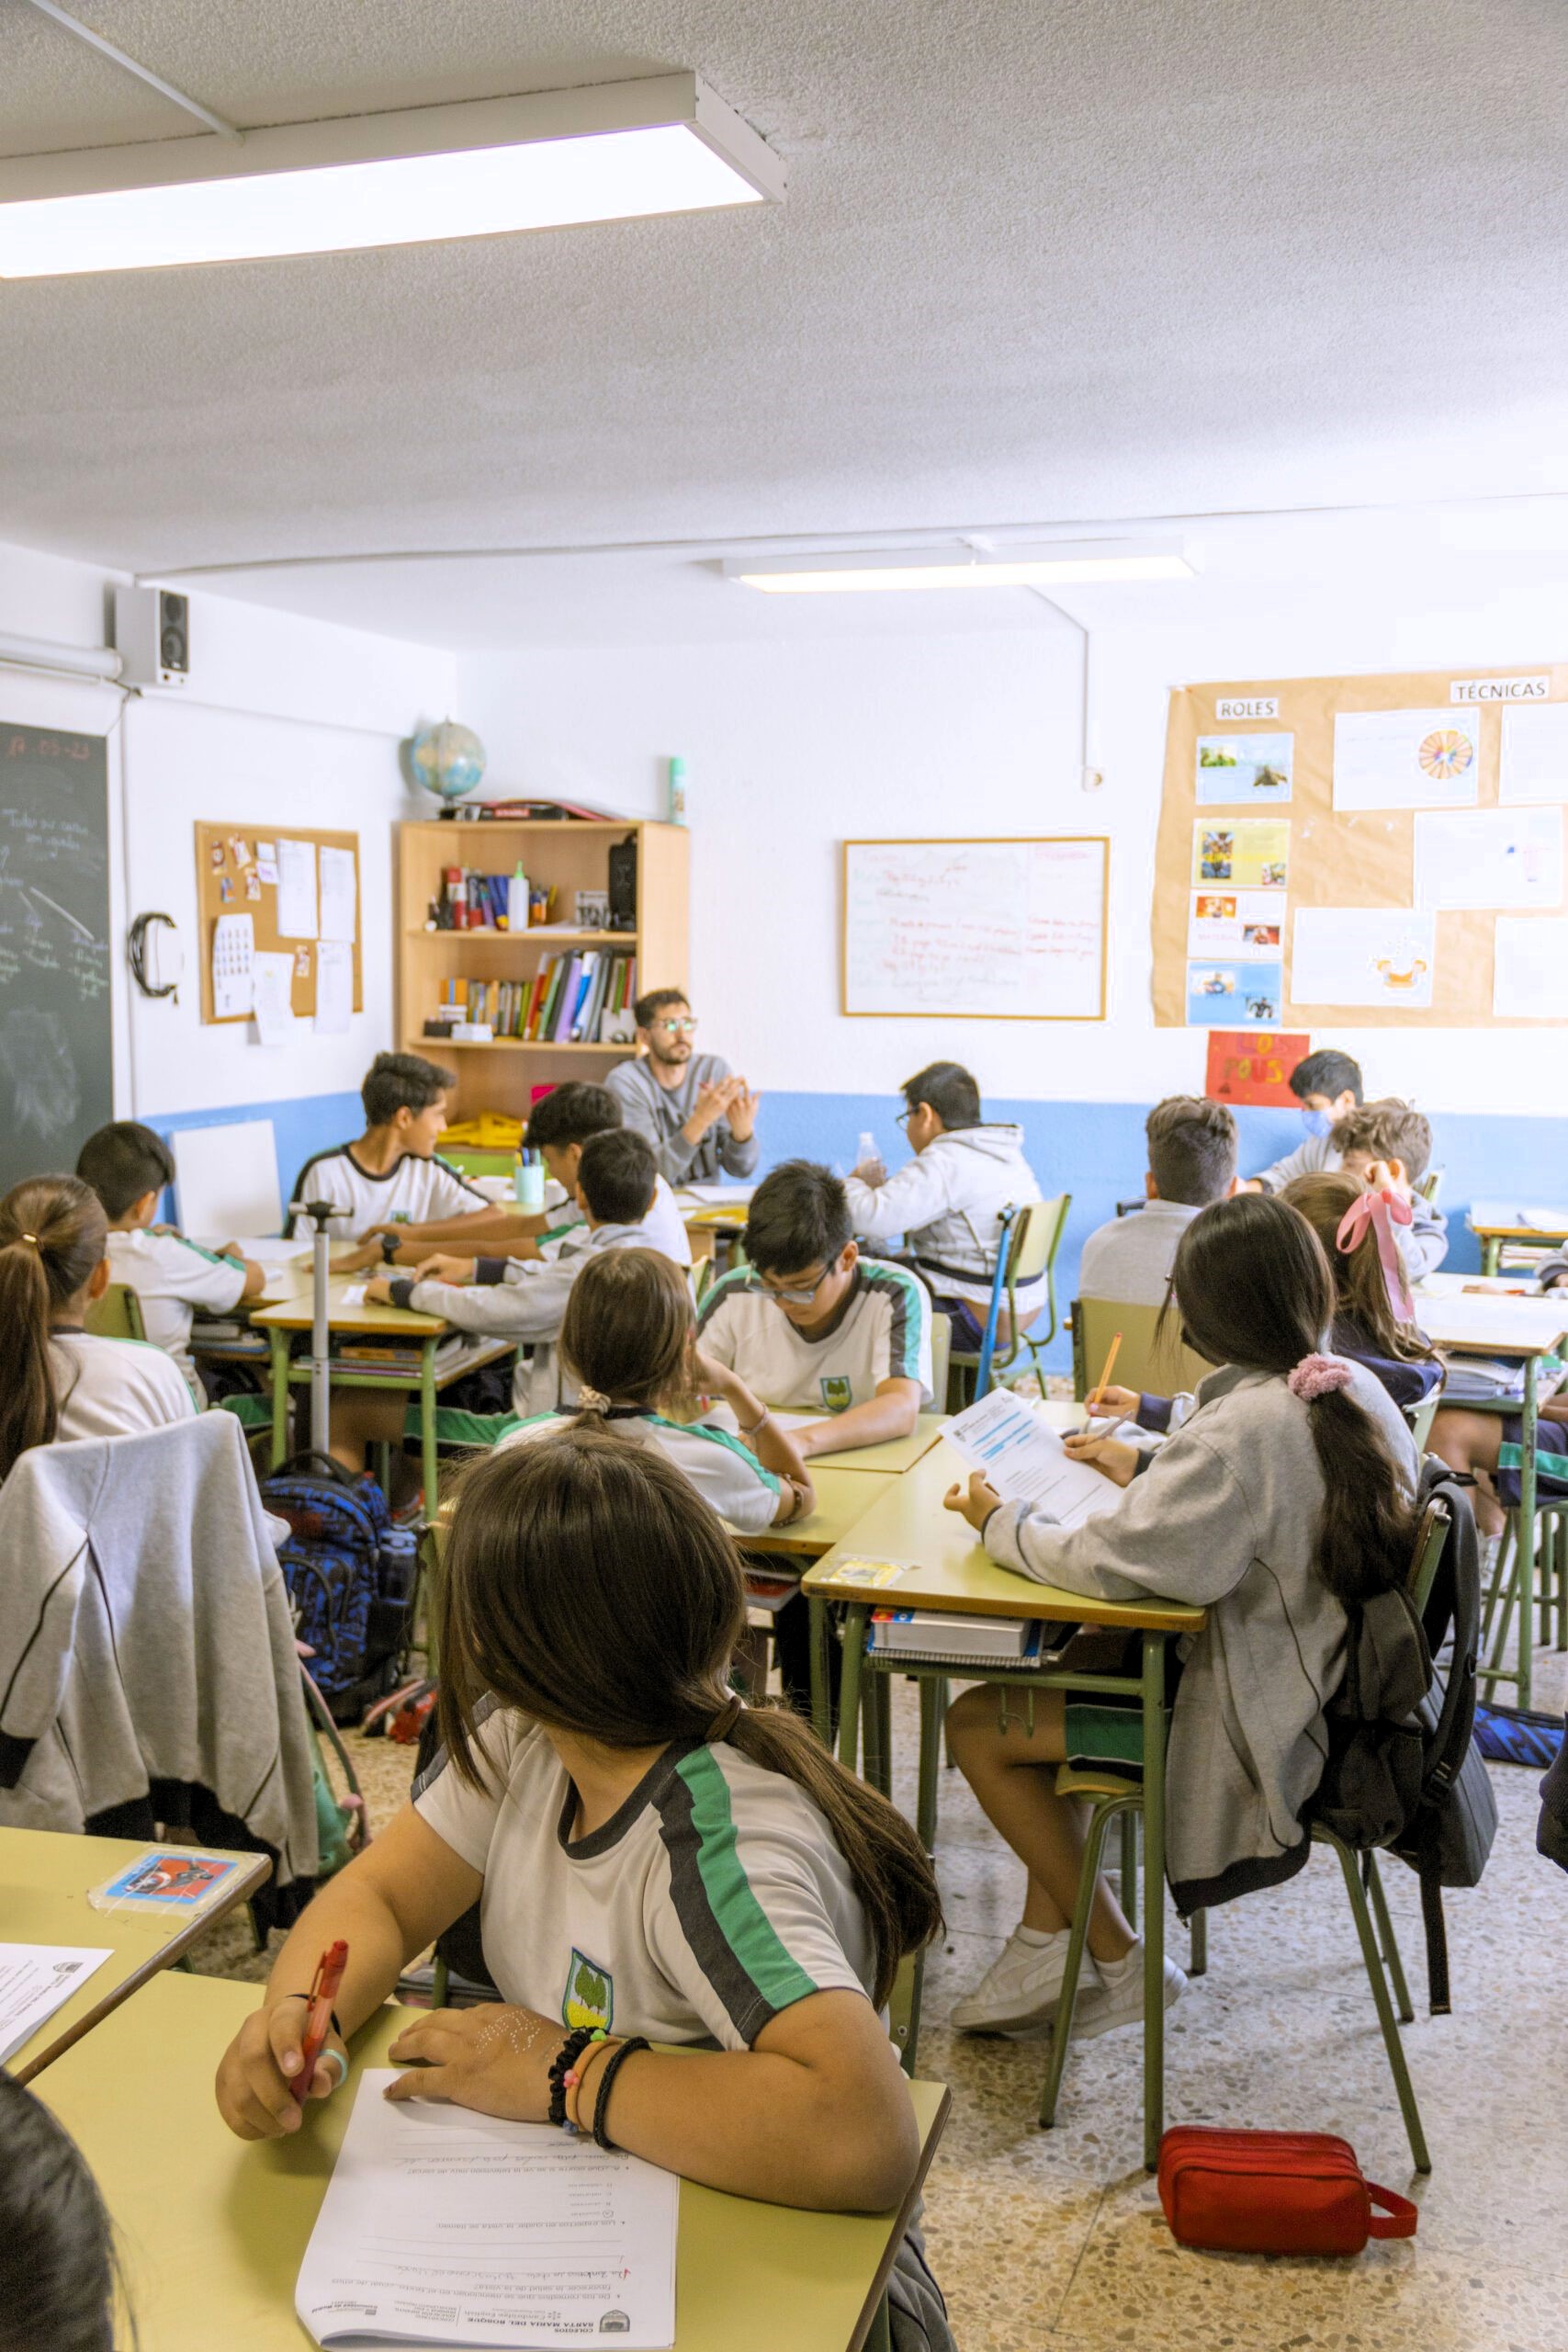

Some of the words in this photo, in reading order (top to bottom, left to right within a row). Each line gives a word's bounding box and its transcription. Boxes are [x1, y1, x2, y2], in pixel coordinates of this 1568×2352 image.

[1456, 681, 1546, 701] TÉCNICAS
[1221, 700, 1274, 718] ROLES
[1235, 1034, 1289, 1055] LOS
[467, 2317, 506, 2325] BOSQUE
